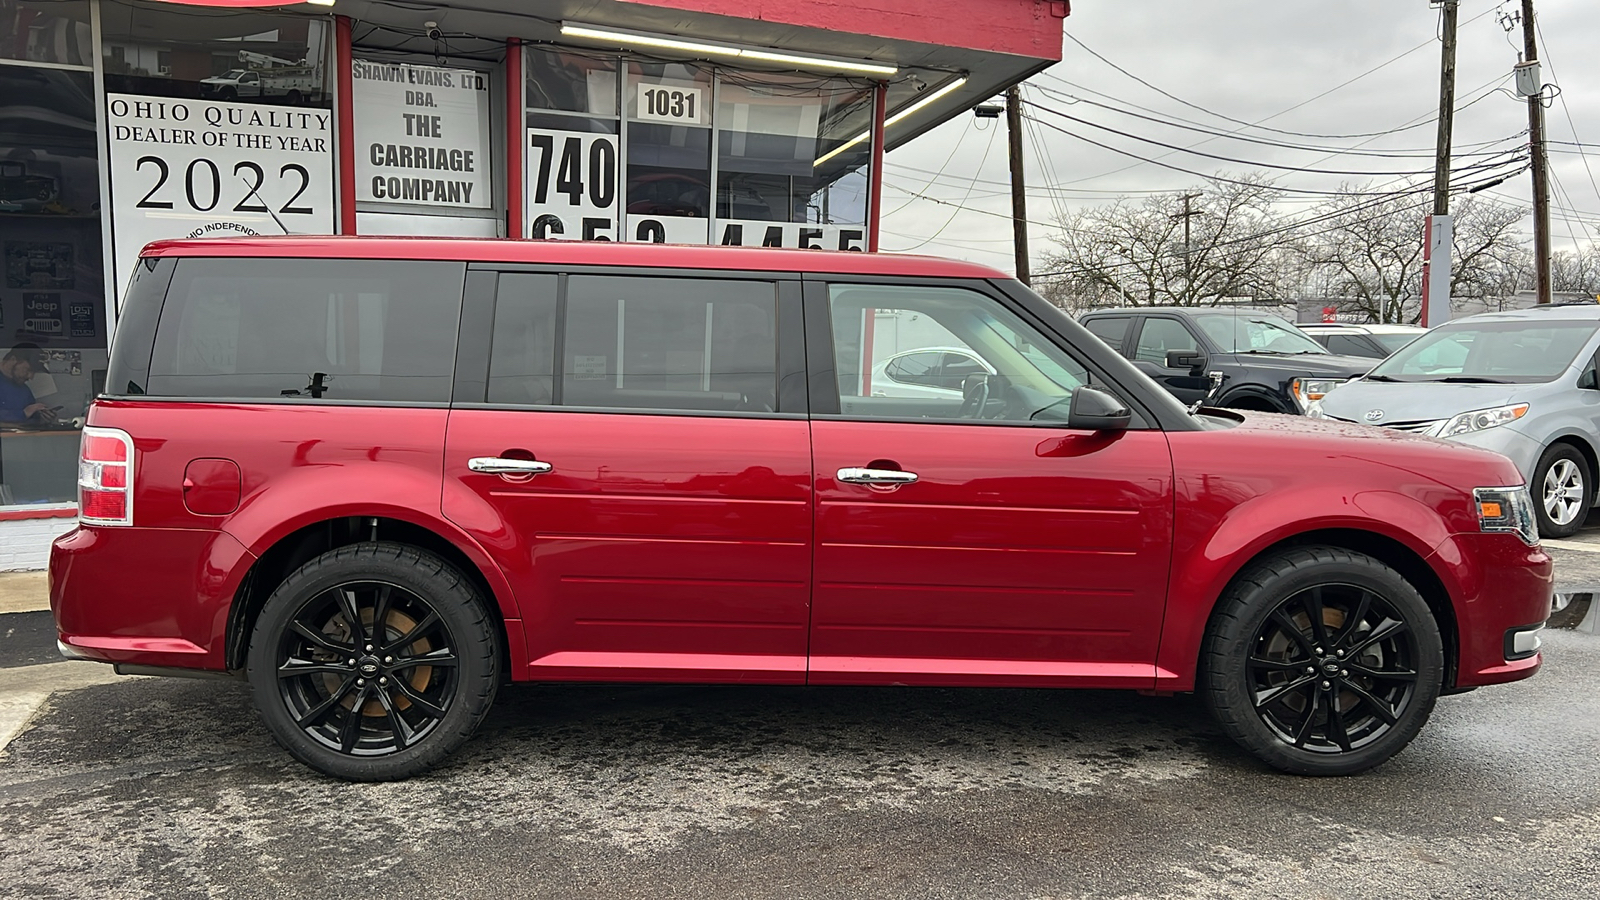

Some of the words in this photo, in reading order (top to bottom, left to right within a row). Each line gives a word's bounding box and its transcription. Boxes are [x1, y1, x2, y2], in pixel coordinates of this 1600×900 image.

[352, 63, 405, 83] SHAWN
[461, 74, 487, 91] LTD.
[405, 90, 438, 107] DBA.
[644, 89, 695, 118] 1031
[110, 99, 190, 121] OHIO
[204, 106, 329, 131] QUALITY
[402, 113, 442, 138] THE
[114, 125, 197, 145] DEALER
[202, 131, 228, 147] OF
[232, 133, 272, 149] THE
[276, 135, 327, 153] YEAR
[370, 143, 474, 172] CARRIAGE
[531, 134, 615, 209] 740
[135, 155, 314, 215] 2022
[372, 175, 474, 204] COMPANY
[185, 228, 203, 239] HIO
[27, 300, 57, 312] Jeep
